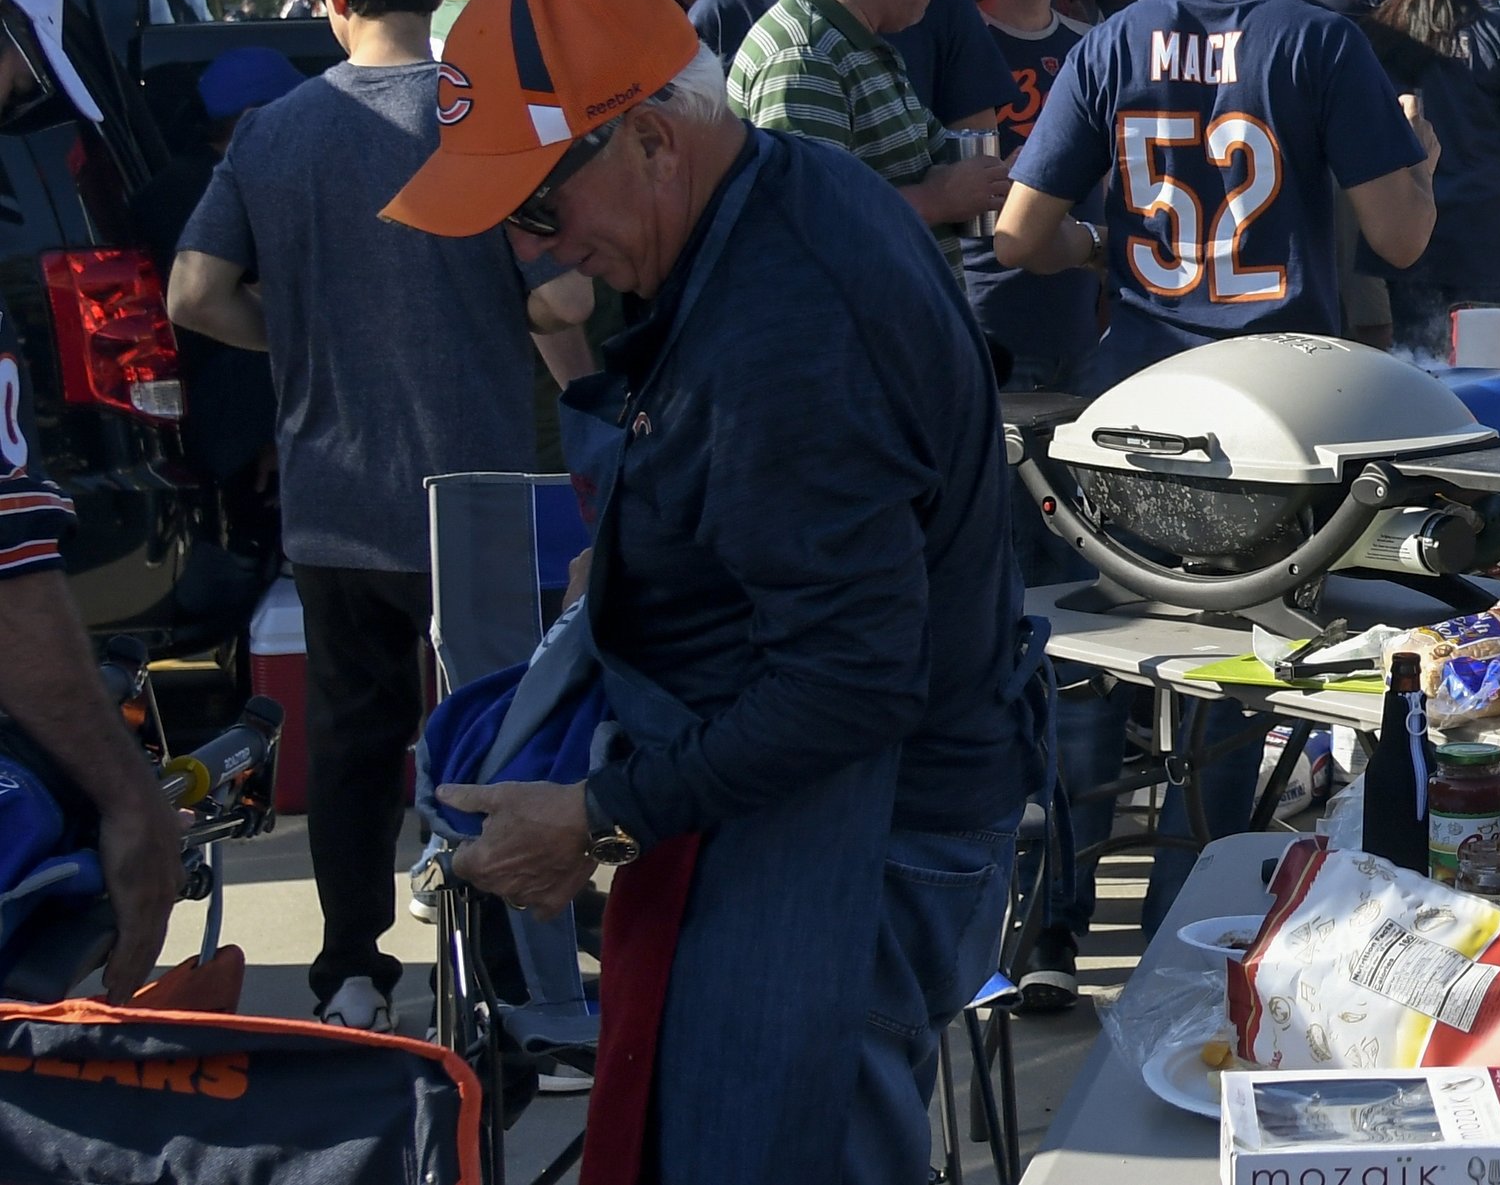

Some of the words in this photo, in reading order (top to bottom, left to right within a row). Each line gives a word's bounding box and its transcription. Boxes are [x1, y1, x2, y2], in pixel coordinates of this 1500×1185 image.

[1151, 27, 1244, 85] MACK
[586, 82, 644, 120] Reebok
[1115, 109, 1288, 304] 52
[1352, 938, 1376, 982] Nutrition
[1375, 922, 1395, 943] Facts
[1398, 933, 1416, 948] 160
[1373, 957, 1395, 992] Calories
[0, 1052, 249, 1101] ARS
